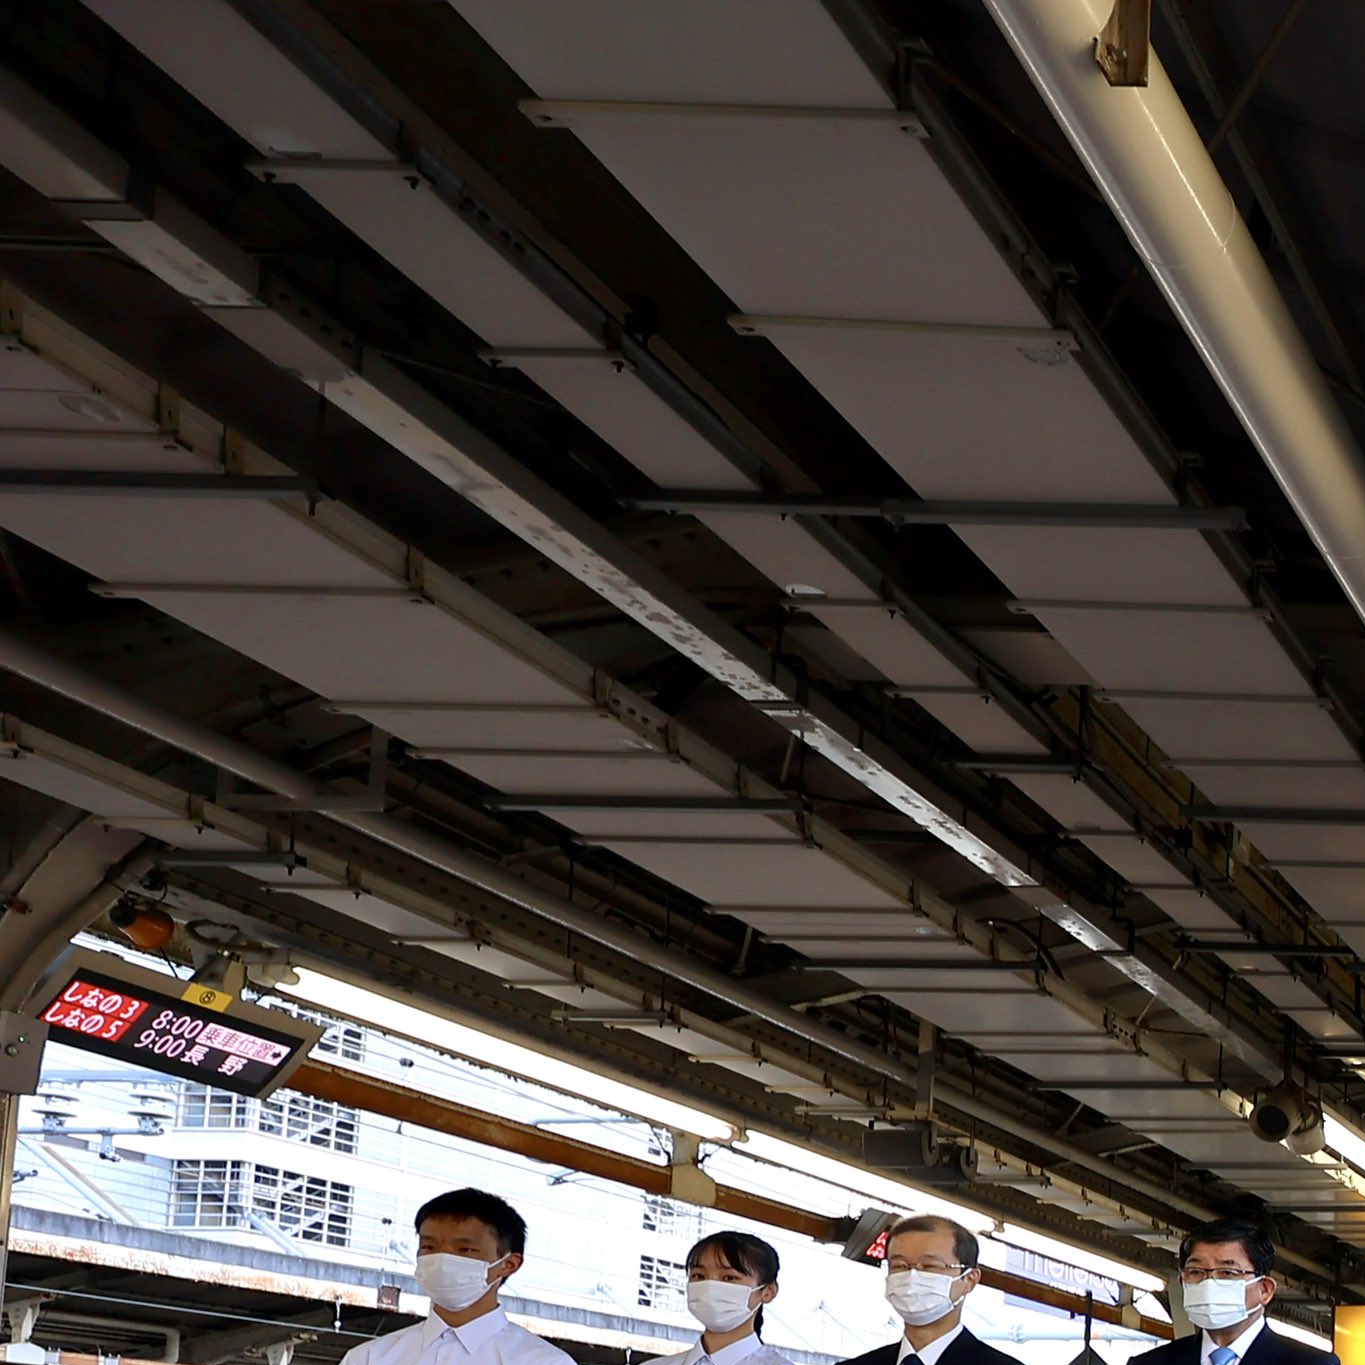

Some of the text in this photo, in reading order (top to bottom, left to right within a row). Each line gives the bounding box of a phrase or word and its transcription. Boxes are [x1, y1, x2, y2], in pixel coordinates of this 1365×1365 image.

[134, 1030, 181, 1058] 9:00
[152, 1010, 202, 1038] 8:00
[200, 1025, 276, 1062] 乗車位置
